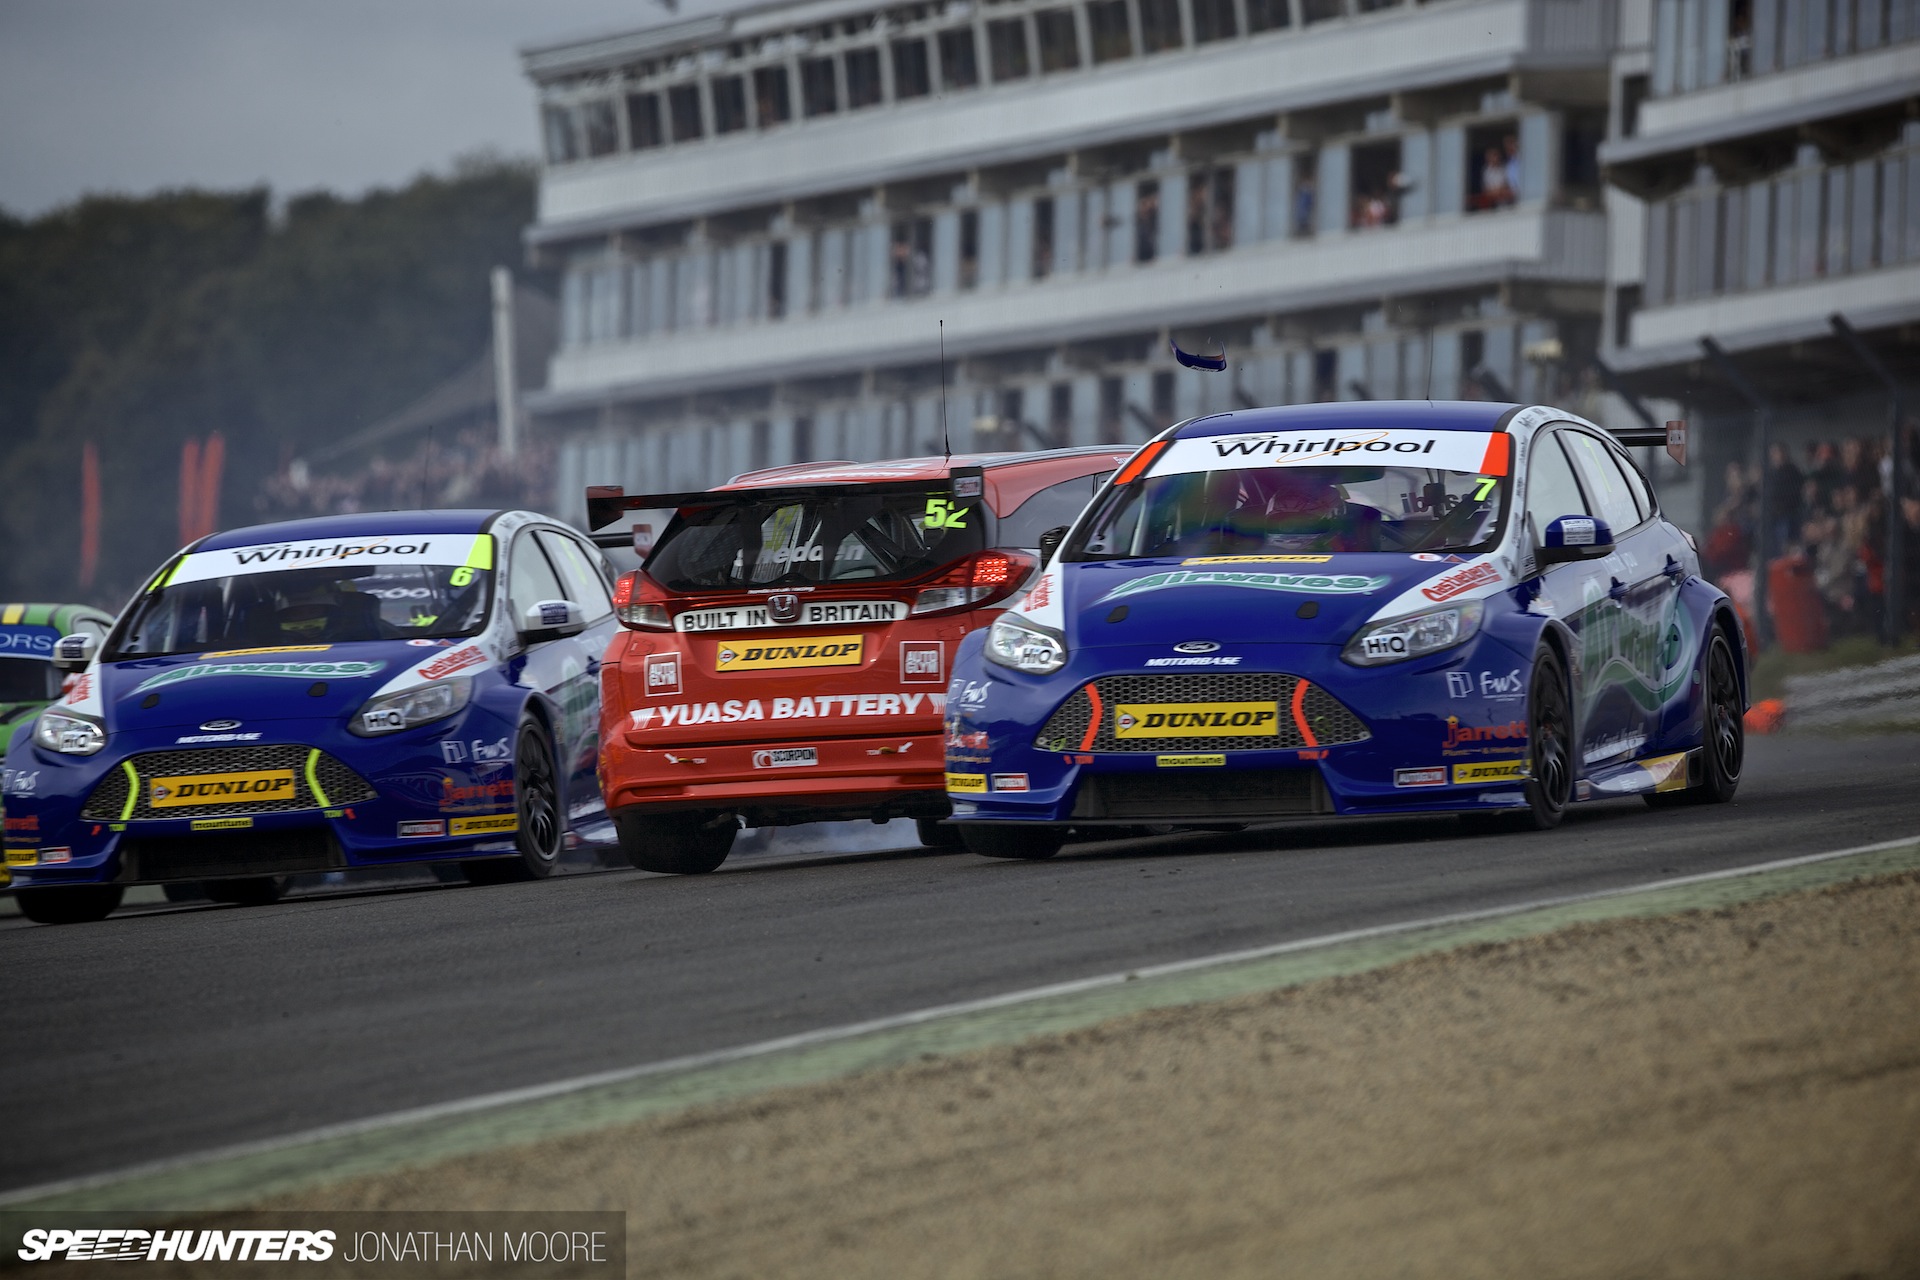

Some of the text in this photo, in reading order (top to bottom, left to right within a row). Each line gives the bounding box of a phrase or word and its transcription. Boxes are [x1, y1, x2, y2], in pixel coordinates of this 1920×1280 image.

[1216, 437, 1437, 457] Whirlpool
[1474, 478, 1497, 501] 7
[924, 498, 970, 528] 52
[235, 542, 432, 565] Whirlpool
[449, 566, 475, 587] 6
[683, 603, 896, 631] BUILT IN BRITAIN
[741, 643, 859, 661] DUNLOP
[1368, 636, 1406, 653] HiQ
[1144, 656, 1242, 667] MOTORBASE
[657, 693, 925, 727] YUASA BATTERY
[1142, 711, 1275, 728] DUNLOP
[175, 777, 291, 798] DUNLOP
